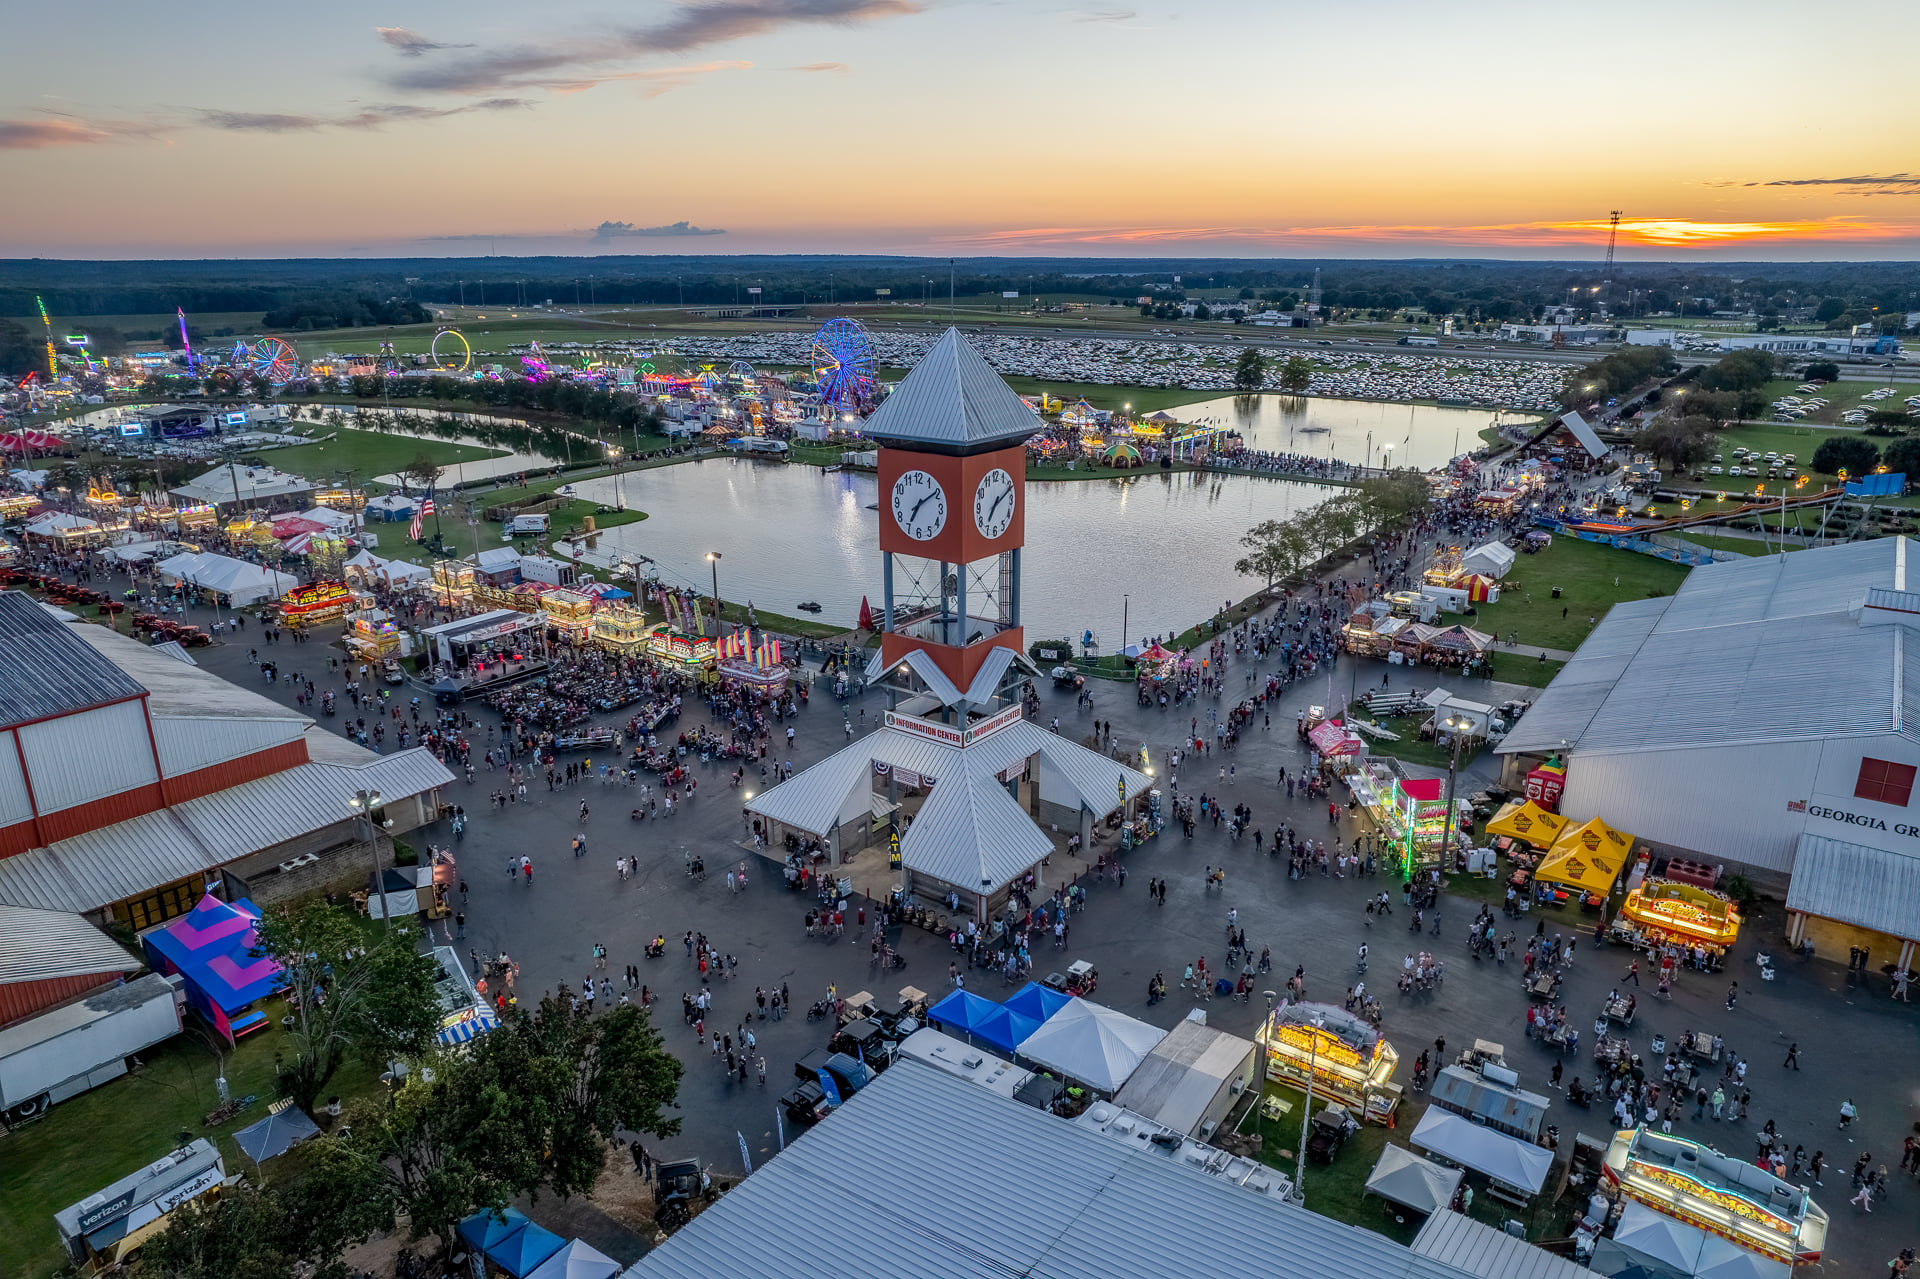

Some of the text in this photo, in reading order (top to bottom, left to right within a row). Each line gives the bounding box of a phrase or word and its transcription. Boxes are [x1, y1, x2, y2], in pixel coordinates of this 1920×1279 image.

[904, 475, 912, 486] 11
[914, 472, 923, 484] 12
[984, 476, 990, 488] 11
[992, 470, 998, 482] 12
[1001, 472, 1004, 484] 1
[894, 483, 904, 495] 10
[927, 478, 930, 488] 1
[936, 488, 940, 499] 2
[978, 488, 984, 499] 10
[894, 497, 900, 508] 9
[1009, 494, 1013, 506] 3
[938, 503, 944, 515] 3
[976, 503, 980, 514] 9
[1006, 509, 1010, 520] 4
[898, 512, 902, 522] 8
[934, 517, 940, 528] 4
[978, 516, 983, 528] 8
[906, 522, 911, 534] 7
[986, 525, 990, 536] 7
[993, 526, 997, 537] 6
[1001, 520, 1004, 531] 5
[916, 528, 922, 538] 6
[927, 526, 932, 538] 5
[972, 709, 1020, 738] INFORMATION CENTER
[896, 717, 961, 743] INFORMATION CENTER
[1809, 805, 1888, 831] GEORGIA
[890, 833, 900, 862] ATM
[164, 1177, 210, 1207] verizon
[1654, 1171, 1768, 1224] CINNAMON
[82, 1198, 127, 1226] verizon
